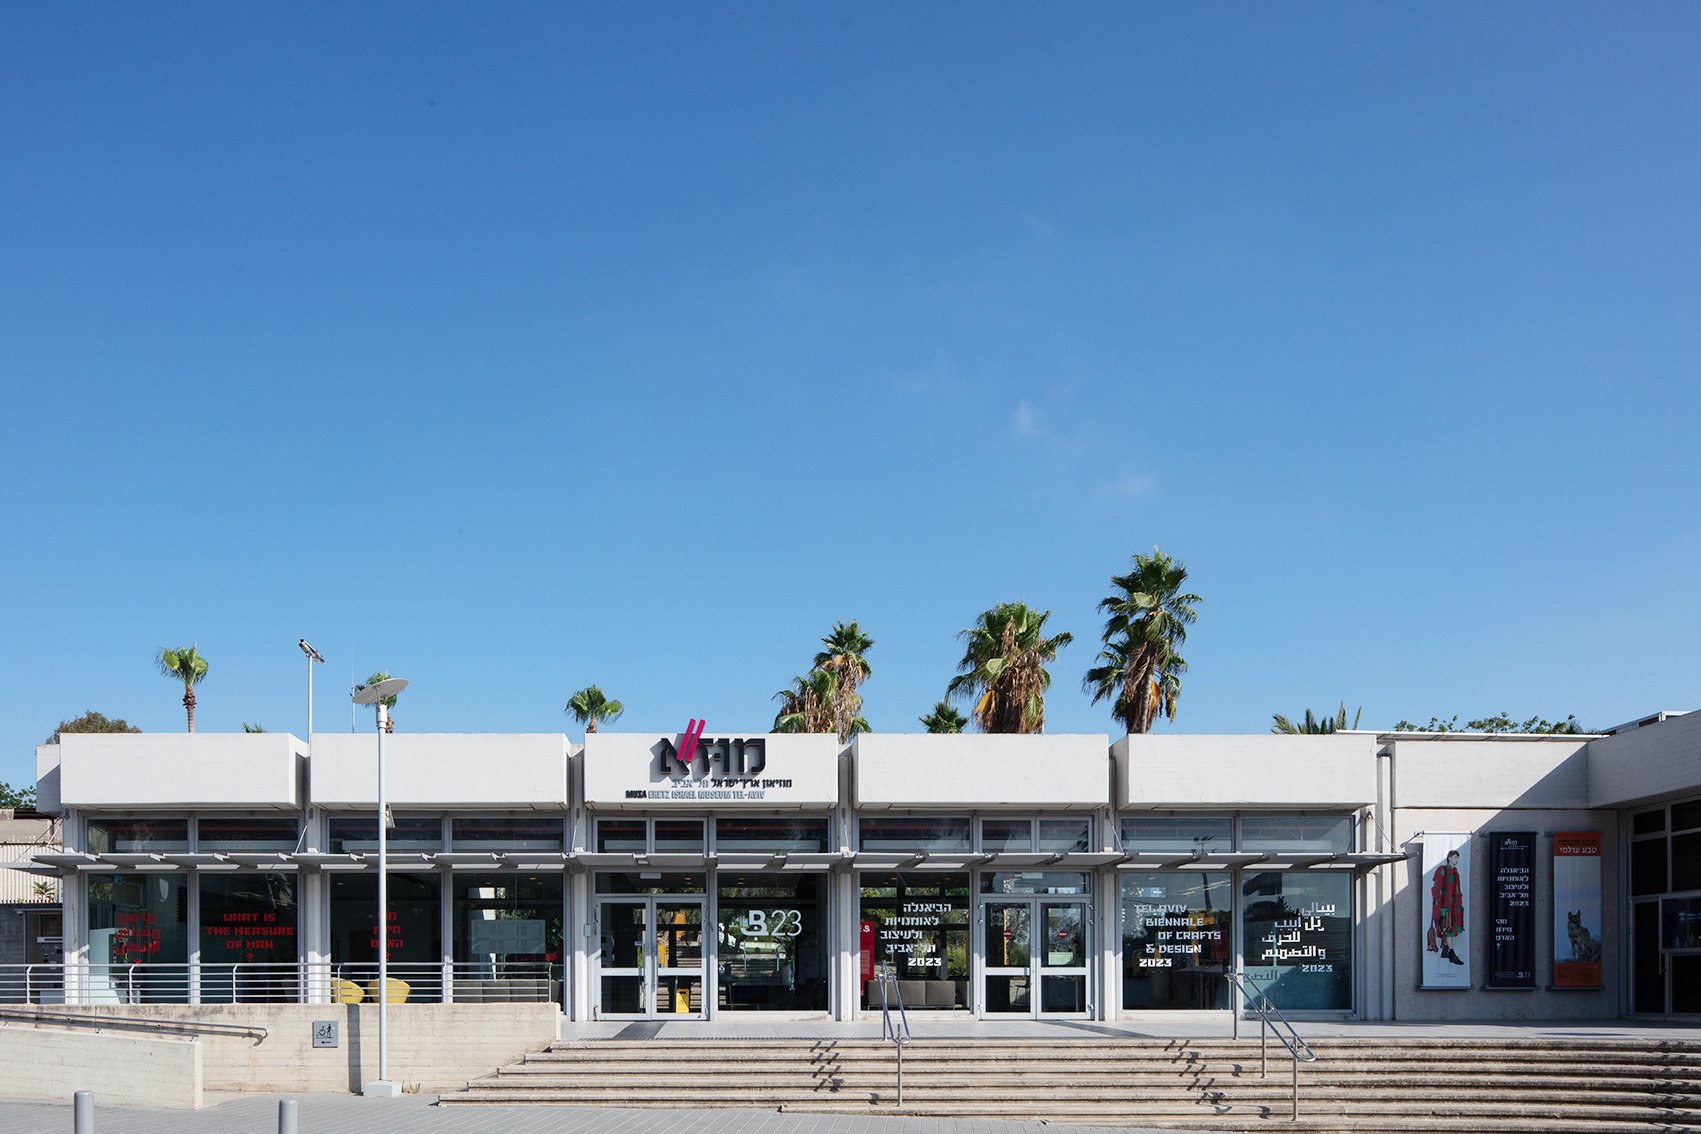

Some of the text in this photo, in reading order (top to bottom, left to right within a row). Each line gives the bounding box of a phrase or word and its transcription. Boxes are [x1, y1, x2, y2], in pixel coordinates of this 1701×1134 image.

[762, 778, 792, 789] מוזיאון
[648, 790, 670, 799] ERETZ
[671, 790, 696, 799] ISRAEL
[698, 790, 731, 799] MUSEUM
[732, 790, 765, 799] TEL-AVIV
[1558, 839, 1581, 847] מקומי
[1559, 845, 1597, 854] טבע עולמי
[903, 902, 952, 912] הביאנלה
[1134, 904, 1188, 913] TEL AVIV
[118, 911, 156, 925] ما هو
[223, 913, 276, 922] WHAT IS
[884, 916, 940, 926] לאומנויות
[1146, 918, 1204, 926] BIENNALE
[115, 925, 160, 940] مقياس
[205, 926, 294, 935] THE MEASURE
[880, 929, 923, 939] ולעיצוב
[1158, 931, 1221, 940] OF CRAFTS
[115, 941, 160, 955] الإنسان
[226, 940, 273, 949] OF MAN
[370, 939, 404, 948] האם
[1146, 943, 1202, 953] & DESIGN
[246, 952, 254, 962] ?
[908, 957, 941, 967] 2023
[1139, 958, 1172, 967] 2023
[1302, 964, 1333, 973] 2023
